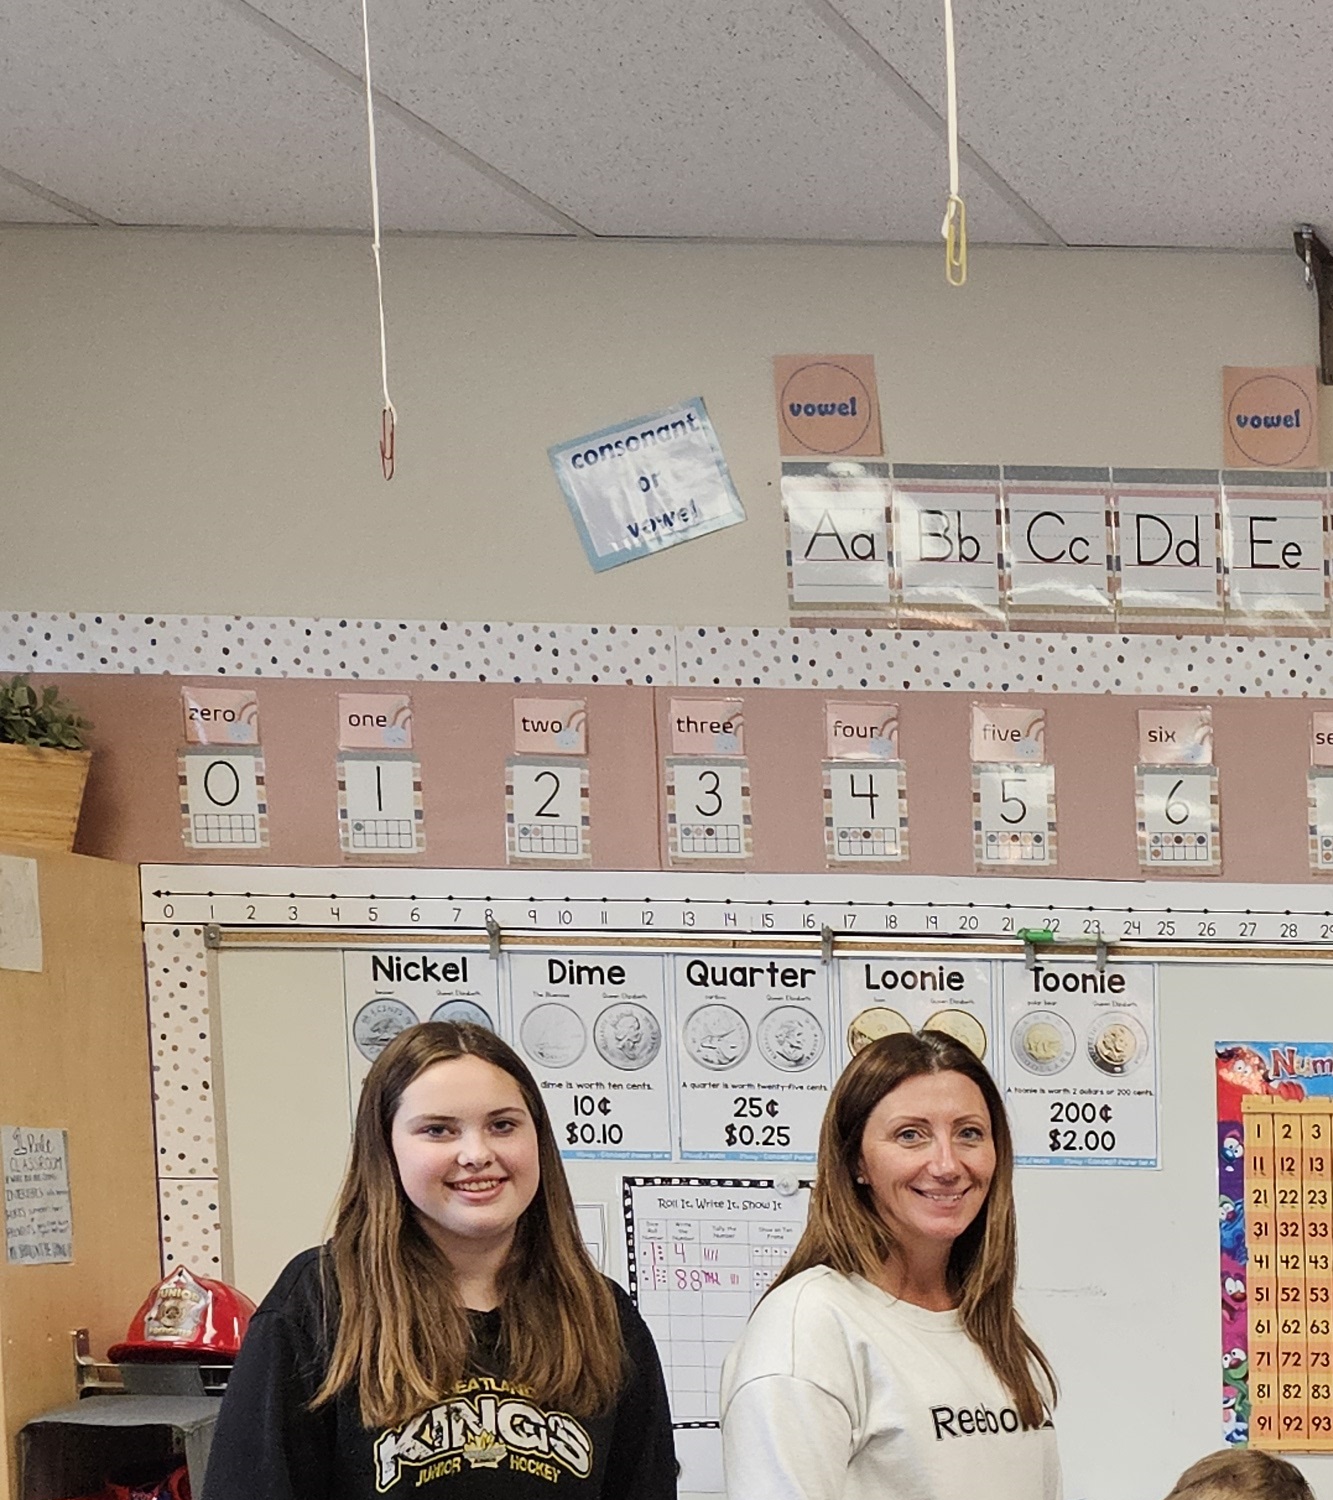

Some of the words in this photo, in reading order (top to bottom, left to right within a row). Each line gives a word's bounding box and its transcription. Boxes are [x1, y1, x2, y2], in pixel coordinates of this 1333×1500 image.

[789, 398, 858, 418] vowel
[1236, 411, 1301, 430] vowel
[570, 412, 699, 470] consonant
[637, 469, 661, 494] or
[627, 499, 699, 540] vowel
[804, 510, 876, 561] Aa
[917, 511, 980, 562] Bb
[1026, 512, 1089, 563] Cc
[1136, 514, 1199, 566] Dd
[1249, 517, 1301, 569] Ee
[189, 707, 235, 723] zero
[348, 712, 387, 727] one
[522, 717, 562, 733] two
[676, 717, 733, 735] three
[833, 721, 878, 738] four
[982, 725, 1021, 743] five
[1148, 726, 1176, 743] six
[204, 760, 239, 806] 0
[534, 771, 560, 817] 2
[695, 770, 722, 816] 3
[849, 773, 878, 819] 4
[1000, 779, 1027, 823] 5
[1166, 780, 1189, 825] 6
[372, 956, 468, 982] Nickel
[548, 959, 626, 985] Dime
[686, 960, 816, 988] Quarter
[865, 964, 964, 991] Loonie
[1031, 967, 1125, 993] Toonie
[573, 1096, 611, 1117] 10¢
[734, 1097, 779, 1119] 25¢
[1050, 1102, 1112, 1123] 200¢
[566, 1121, 624, 1146] $0.10
[724, 1124, 791, 1148] $0.25
[1049, 1130, 1116, 1152] $2.00
[375, 1396, 592, 1492] KINGS
[416, 1456, 461, 1487] JUNIOR
[510, 1455, 561, 1484] HOCKEY
